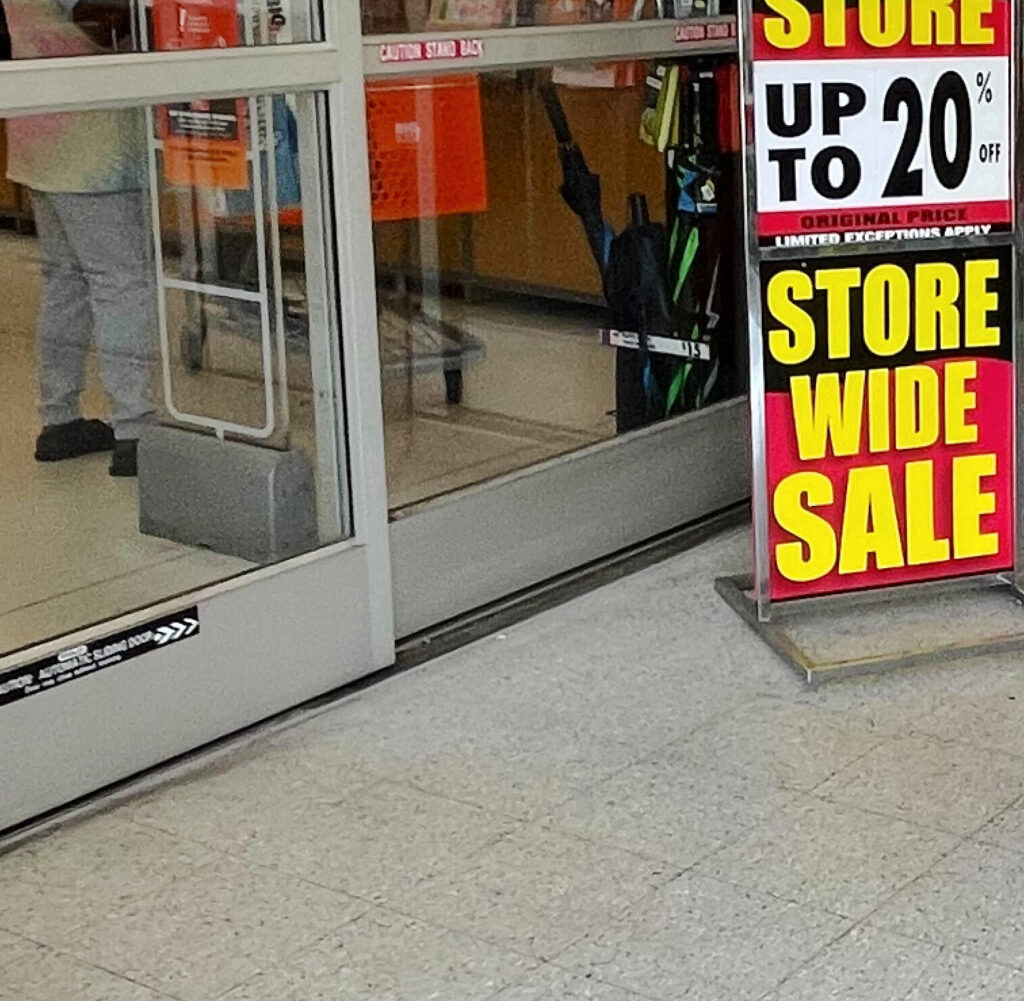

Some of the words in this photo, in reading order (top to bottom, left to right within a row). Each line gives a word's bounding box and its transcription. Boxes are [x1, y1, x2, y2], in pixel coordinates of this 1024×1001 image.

[381, 43, 421, 61] CAUTION
[424, 41, 456, 58] STAND
[460, 39, 483, 56] BACK
[766, 82, 866, 137] UP
[768, 145, 861, 202] TO
[979, 144, 1000, 163] OFF
[775, 232, 841, 247] LIMITED
[844, 226, 941, 243] EXCEPTIONS
[944, 224, 992, 237] APPLY
[801, 211, 901, 229] ORIGINAL
[907, 207, 968, 223] PRICE
[767, 259, 1000, 365] STORE
[790, 360, 978, 460] WIDE
[773, 453, 999, 582] SALE
